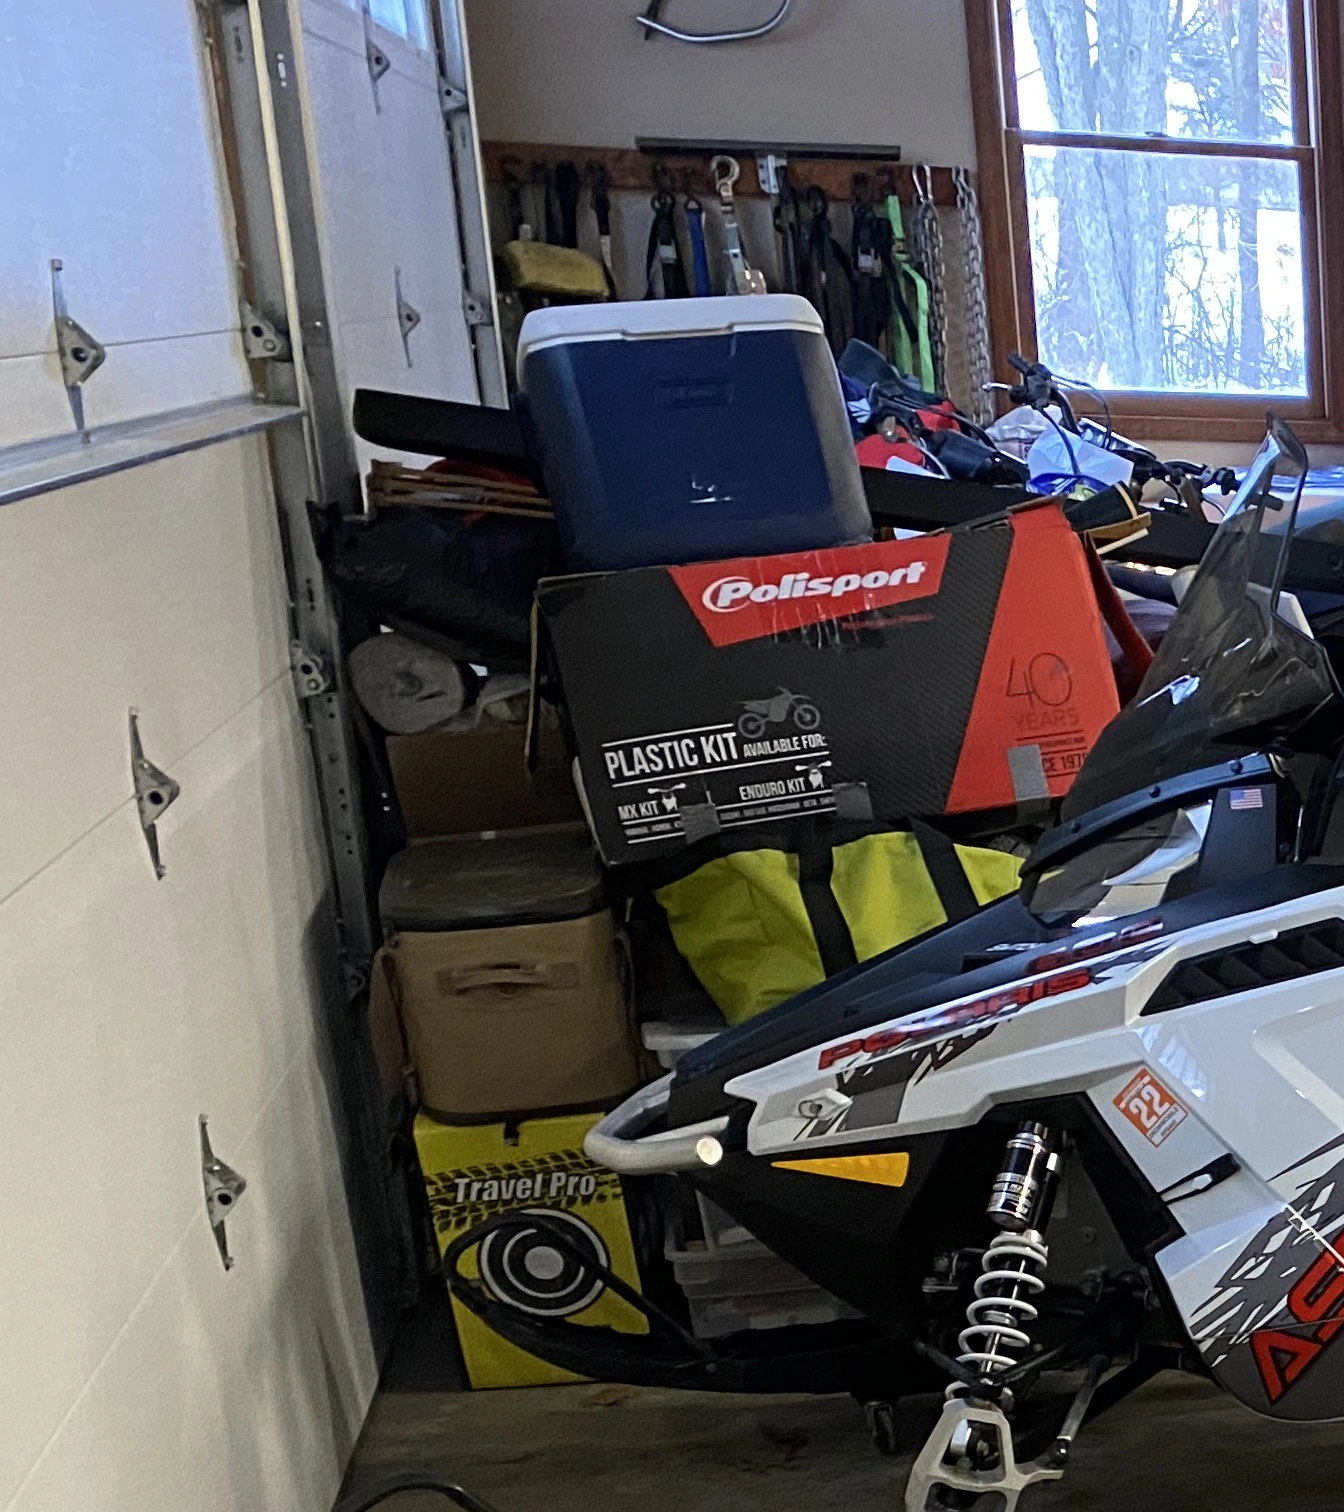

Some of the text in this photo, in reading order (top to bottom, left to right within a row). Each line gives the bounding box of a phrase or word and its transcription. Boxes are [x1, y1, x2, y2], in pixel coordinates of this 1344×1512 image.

[702, 560, 928, 613] Polisport
[1005, 651, 1074, 709] 40
[1011, 707, 1080, 731] YEARS
[604, 731, 739, 780] PLASTIC KIT
[742, 736, 801, 758] AVAILABLE
[738, 777, 806, 801] ENDURO KIT
[617, 800, 659, 821] MX KIT
[1128, 1084, 1170, 1128] 22
[453, 1171, 597, 1203] Travel Pro
